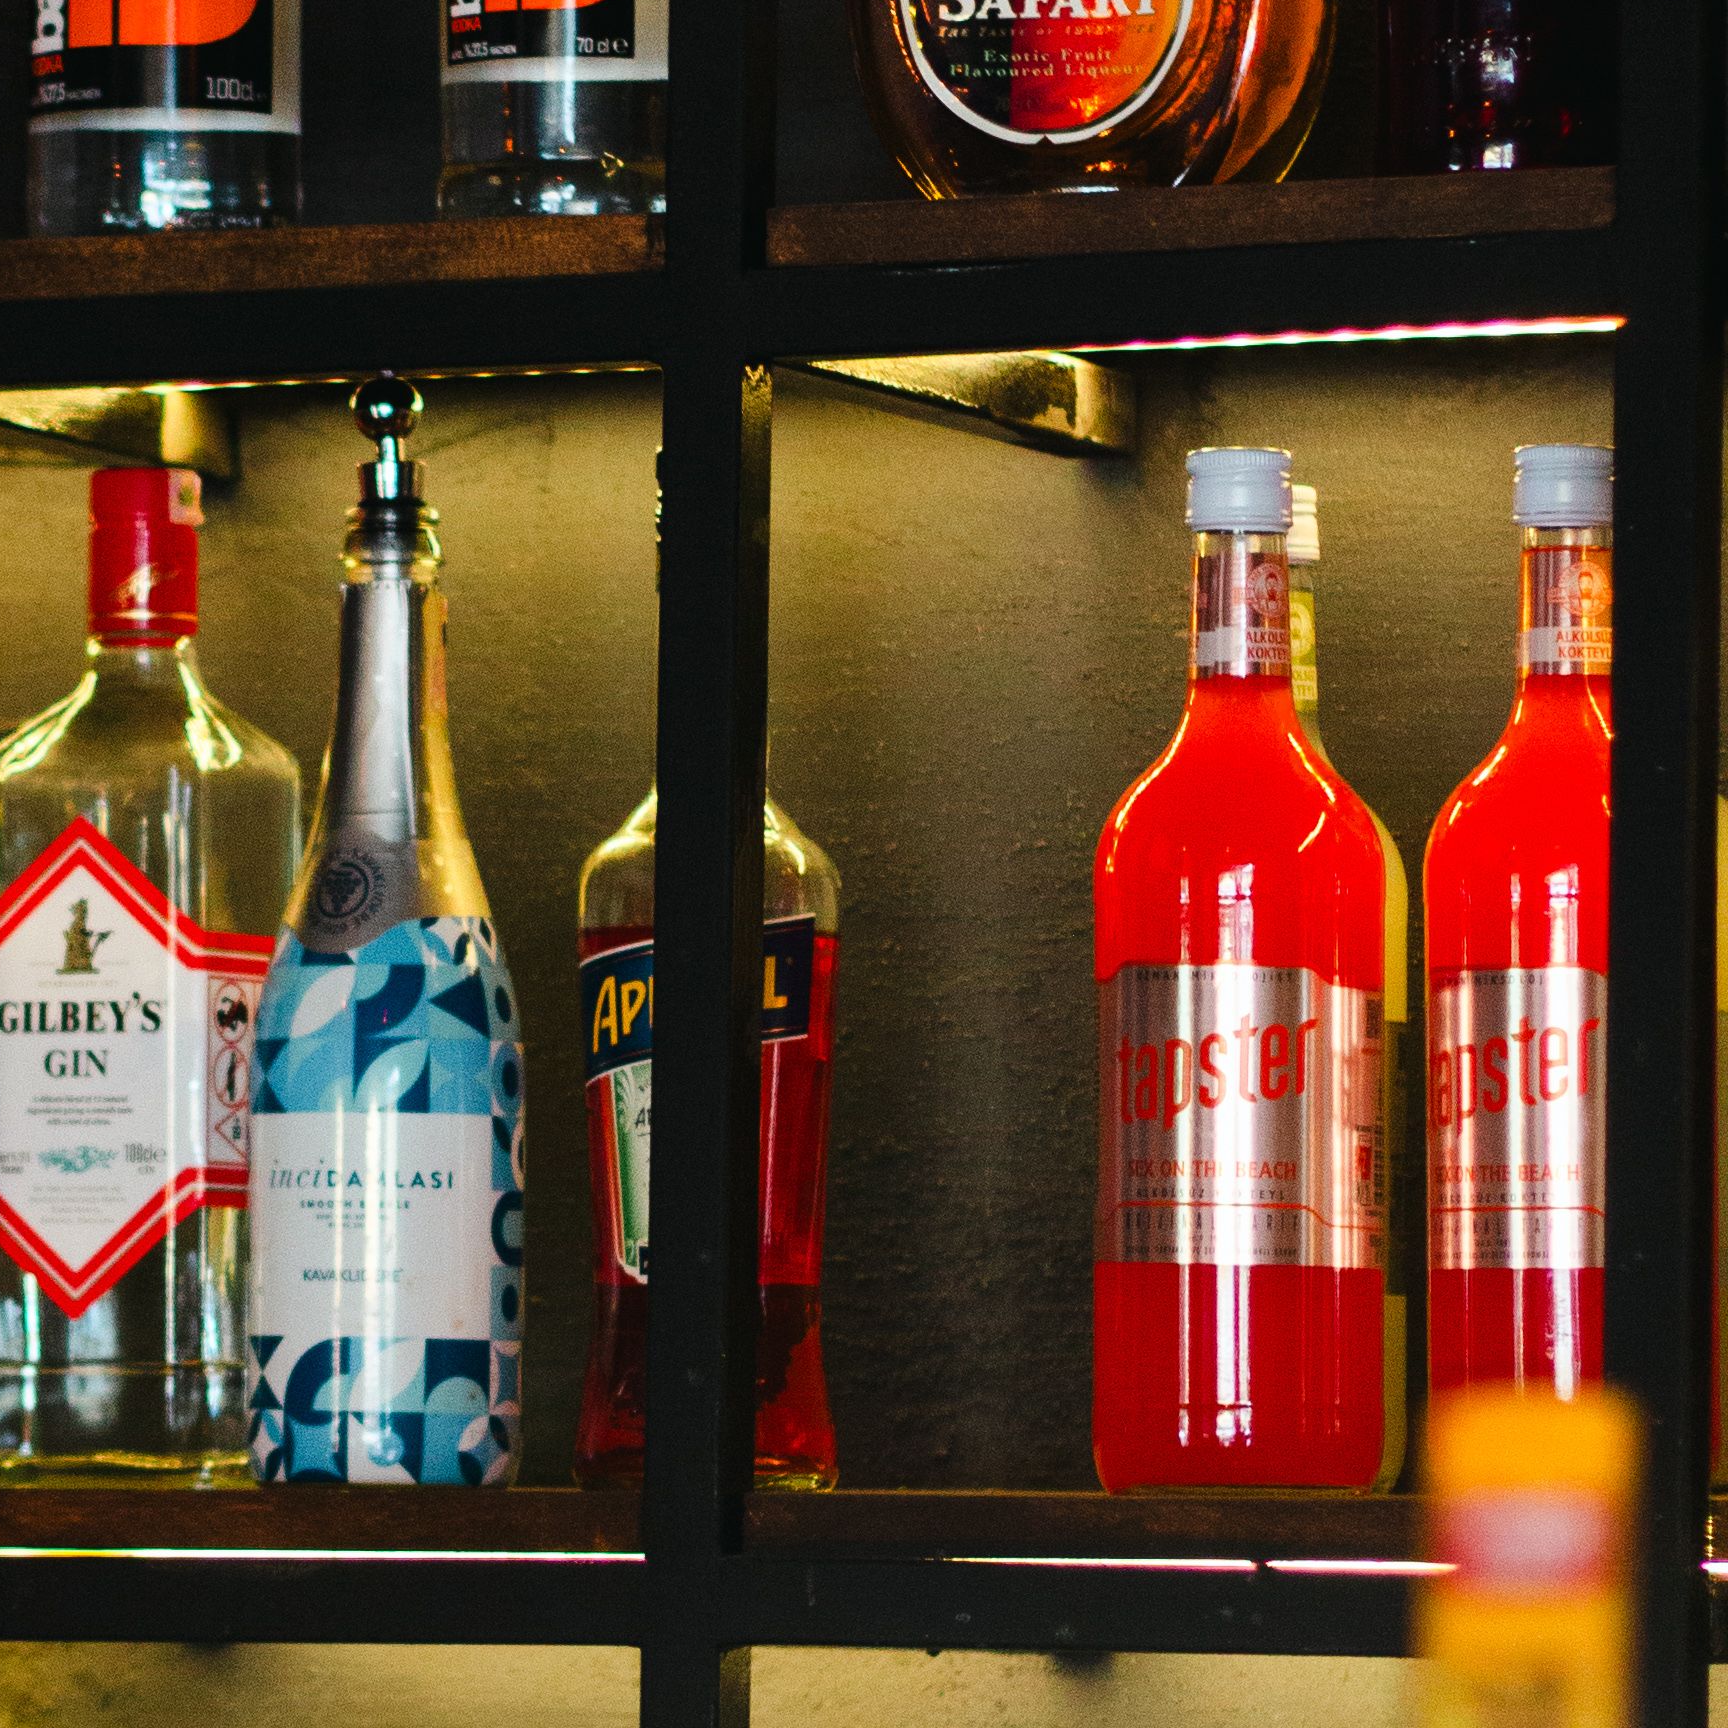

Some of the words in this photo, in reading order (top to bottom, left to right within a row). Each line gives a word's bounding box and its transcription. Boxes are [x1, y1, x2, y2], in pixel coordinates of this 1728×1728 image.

[983, 48, 1051, 63] Exotic
[1060, 47, 1113, 62] Fruit
[949, 63, 1055, 78] Flavoured
[1065, 62, 1145, 79] Liqueur
[43, 1048, 110, 1079] GIN
[1429, 1015, 1602, 1136] apster
[1518, 1164, 1582, 1183] BEAH
[300, 1199, 353, 1209] SMOOH
